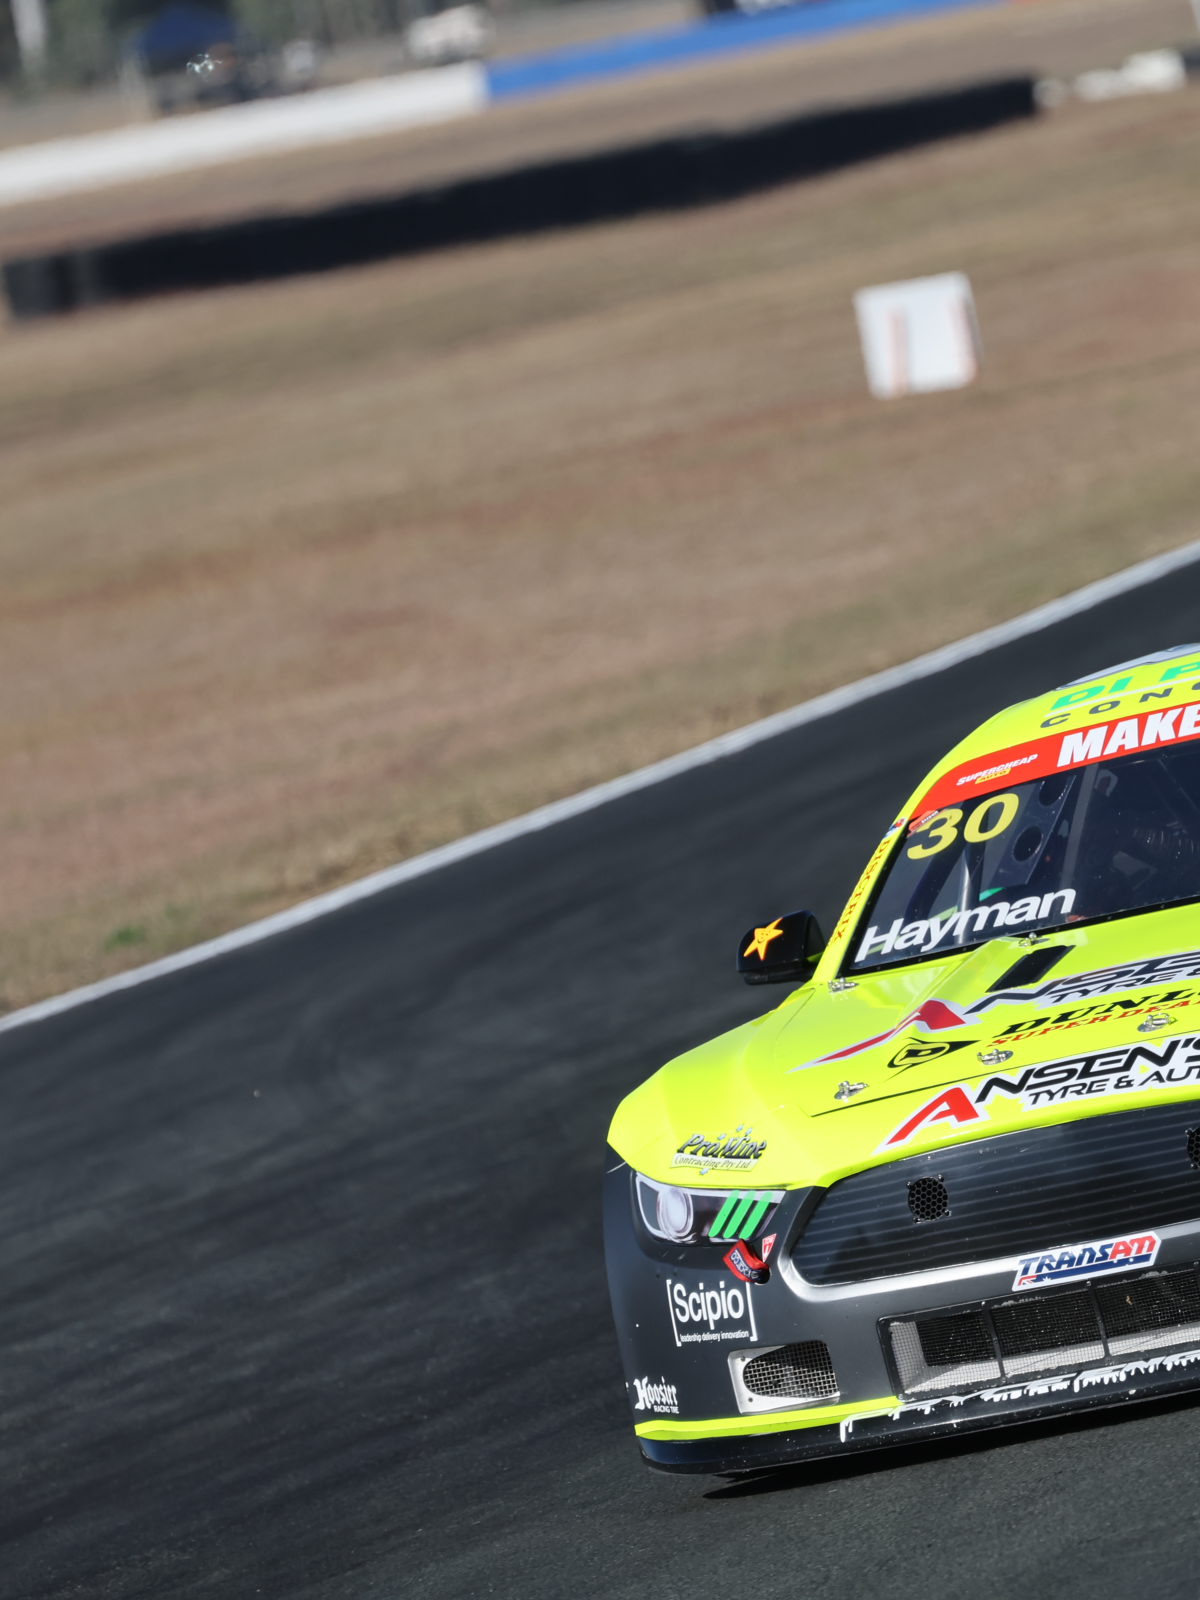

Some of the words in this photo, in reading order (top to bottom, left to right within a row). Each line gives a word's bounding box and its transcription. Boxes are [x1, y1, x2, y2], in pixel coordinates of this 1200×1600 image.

[1051, 676, 1133, 710] DI
[956, 754, 1039, 786] SUPERCHEAP
[907, 793, 1020, 860] 30
[854, 888, 1077, 963] Hayman
[1052, 971, 1182, 1003] TYRE
[987, 1013, 1109, 1048] SUPER
[1029, 1078, 1109, 1105] TYRE
[1113, 1075, 1136, 1090] &
[677, 1133, 767, 1159] ProMine
[680, 1332, 701, 1343] leadership
[701, 1331, 721, 1341] delivery
[721, 1329, 749, 1339] innovation
[633, 1375, 678, 1410] Hoosier
